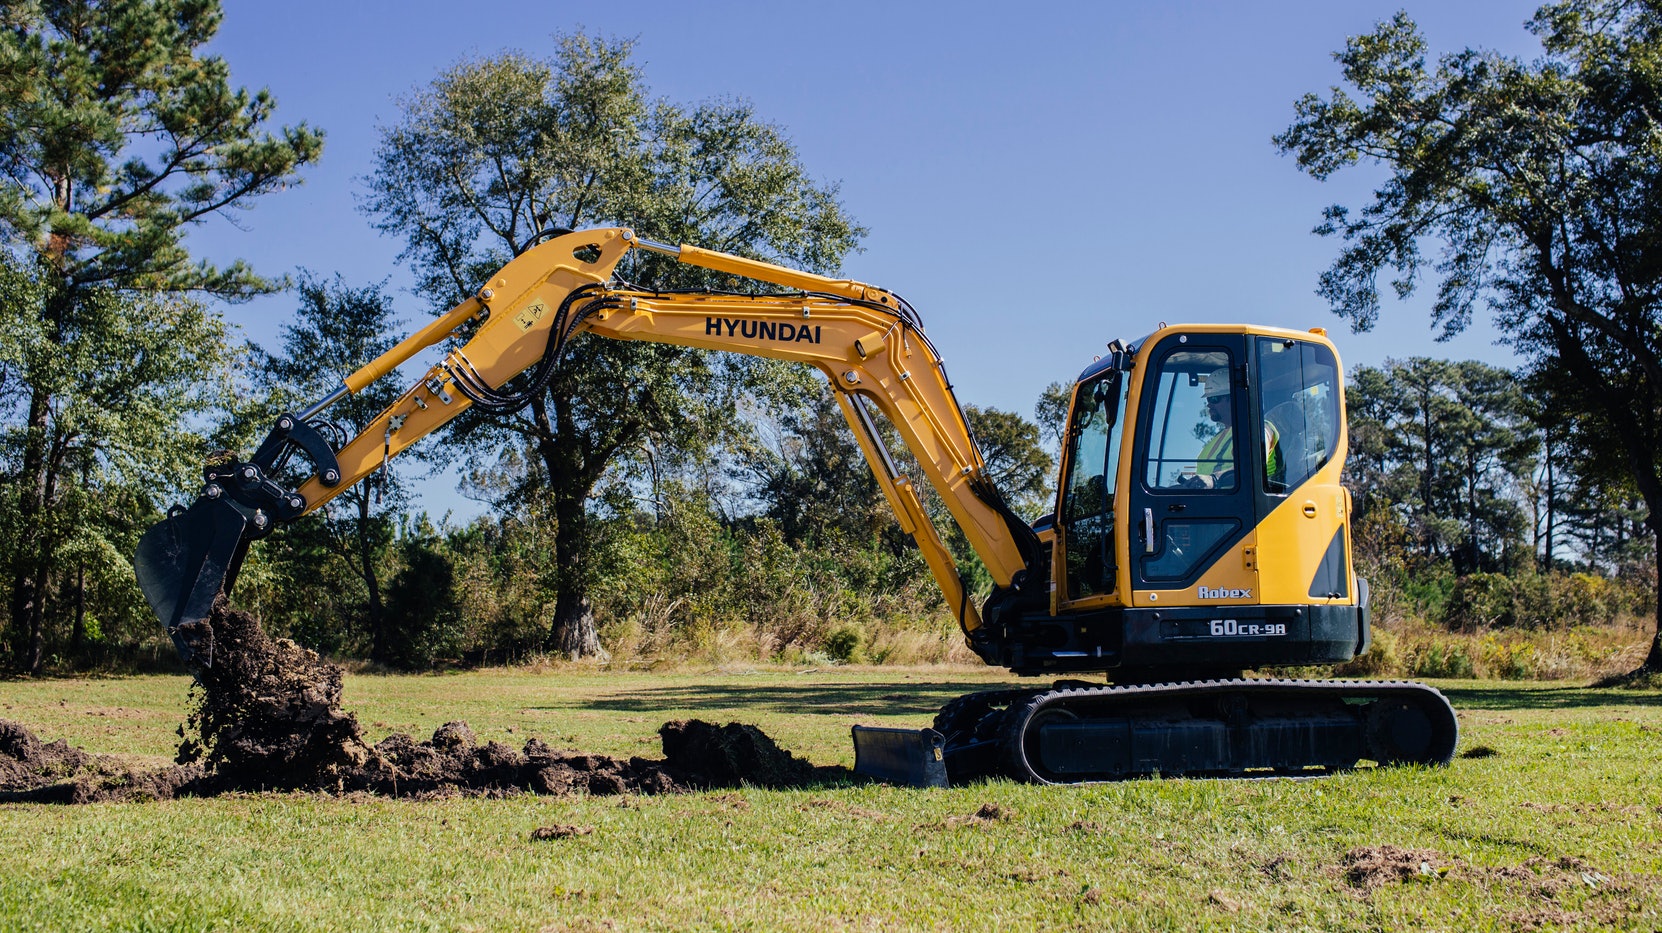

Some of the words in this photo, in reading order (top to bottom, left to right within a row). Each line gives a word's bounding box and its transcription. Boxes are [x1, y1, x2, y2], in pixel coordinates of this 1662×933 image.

[705, 316, 821, 344] HYUNDAI
[1197, 585, 1252, 599] Robex
[1210, 619, 1286, 636] 60CR-9A
